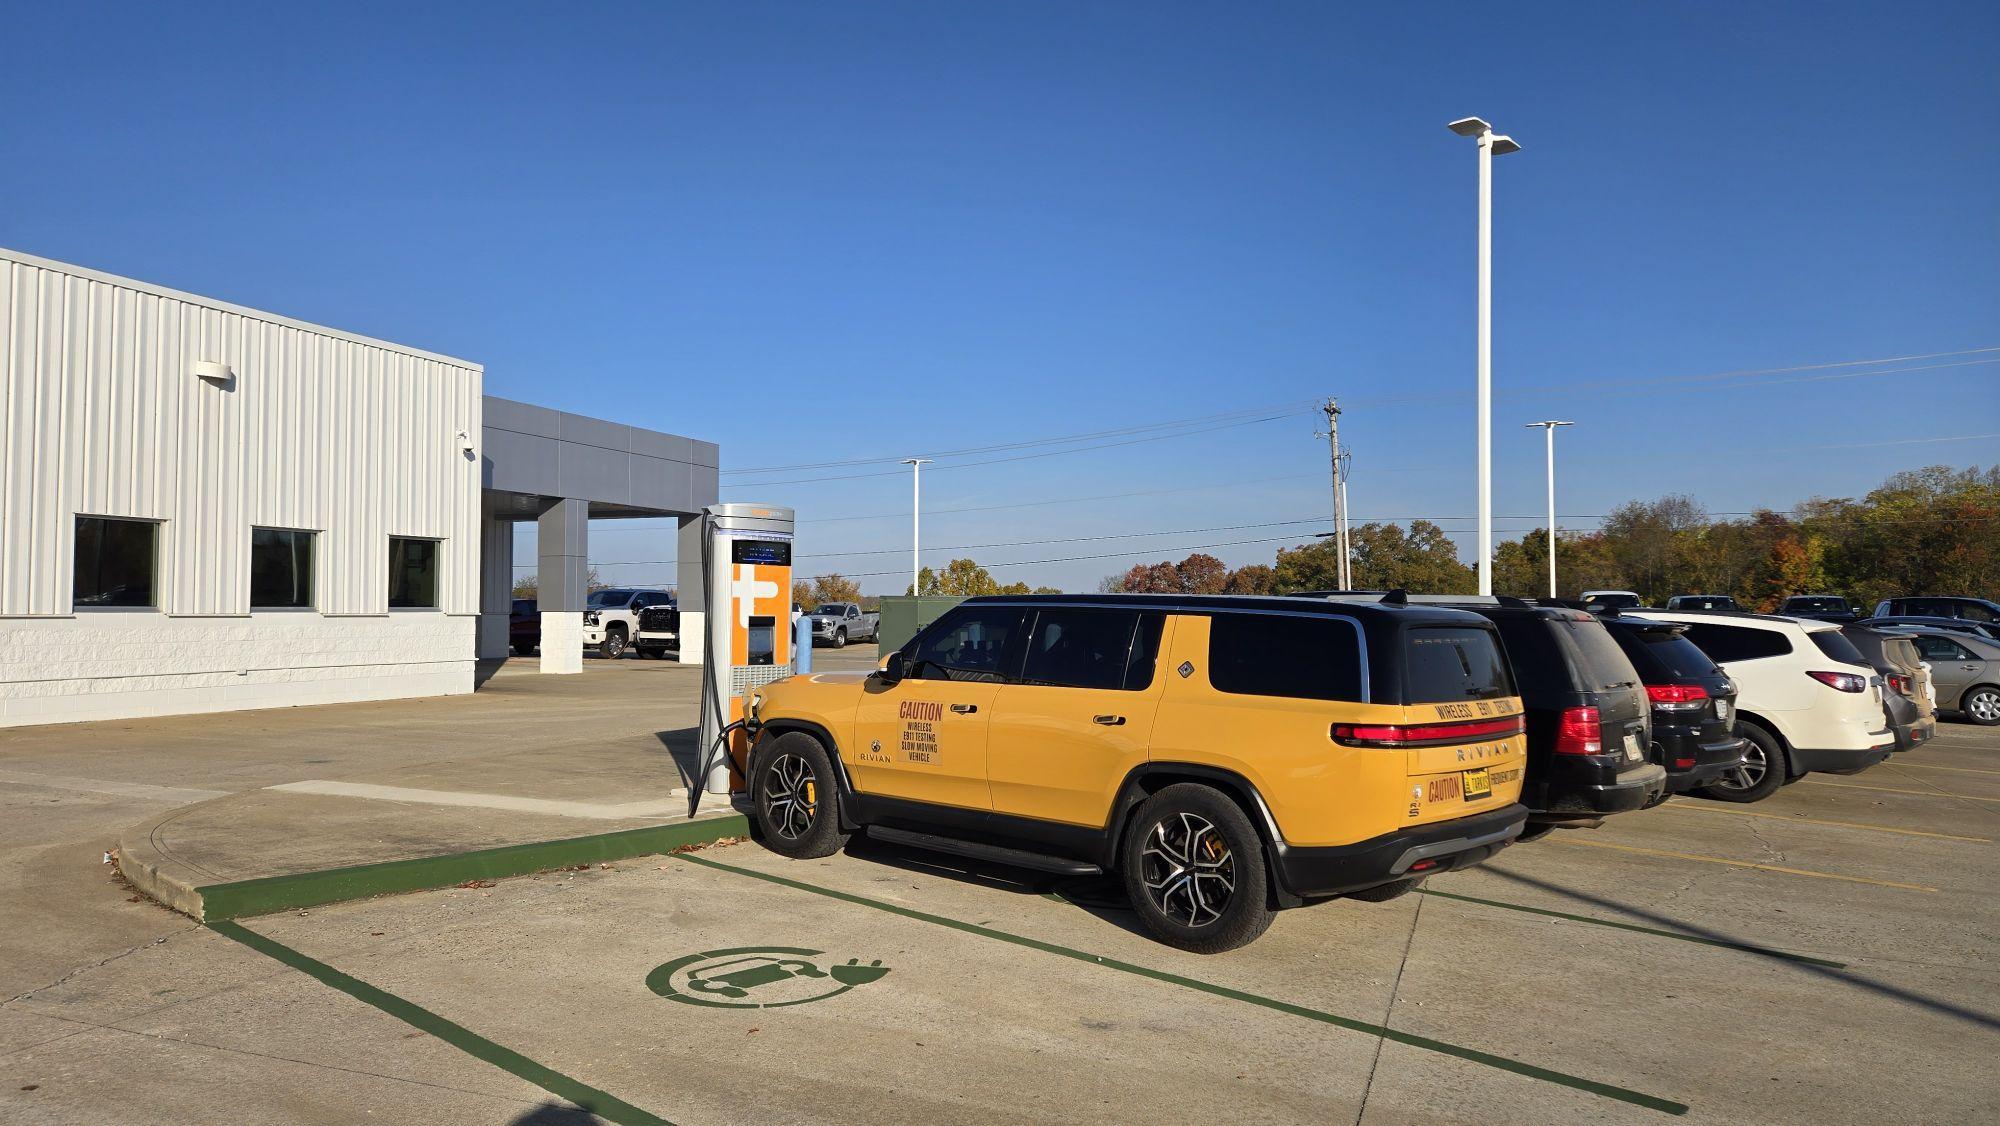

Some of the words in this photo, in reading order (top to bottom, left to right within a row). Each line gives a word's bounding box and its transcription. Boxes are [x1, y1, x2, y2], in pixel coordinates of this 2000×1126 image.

[900, 701, 943, 721] CAUTION
[1435, 704, 1473, 719] WIRELESS
[907, 722, 932, 732] WIRELESS
[903, 731, 914, 740] E911
[915, 732, 936, 743] TESTING
[902, 741, 915, 751] SLOW
[916, 742, 937, 753] MOVING
[1456, 742, 1509, 761] RIVIAN
[860, 753, 891, 763] RIVIAN
[909, 752, 930, 762] VEHICLE
[1428, 777, 1461, 802] CAUTION
